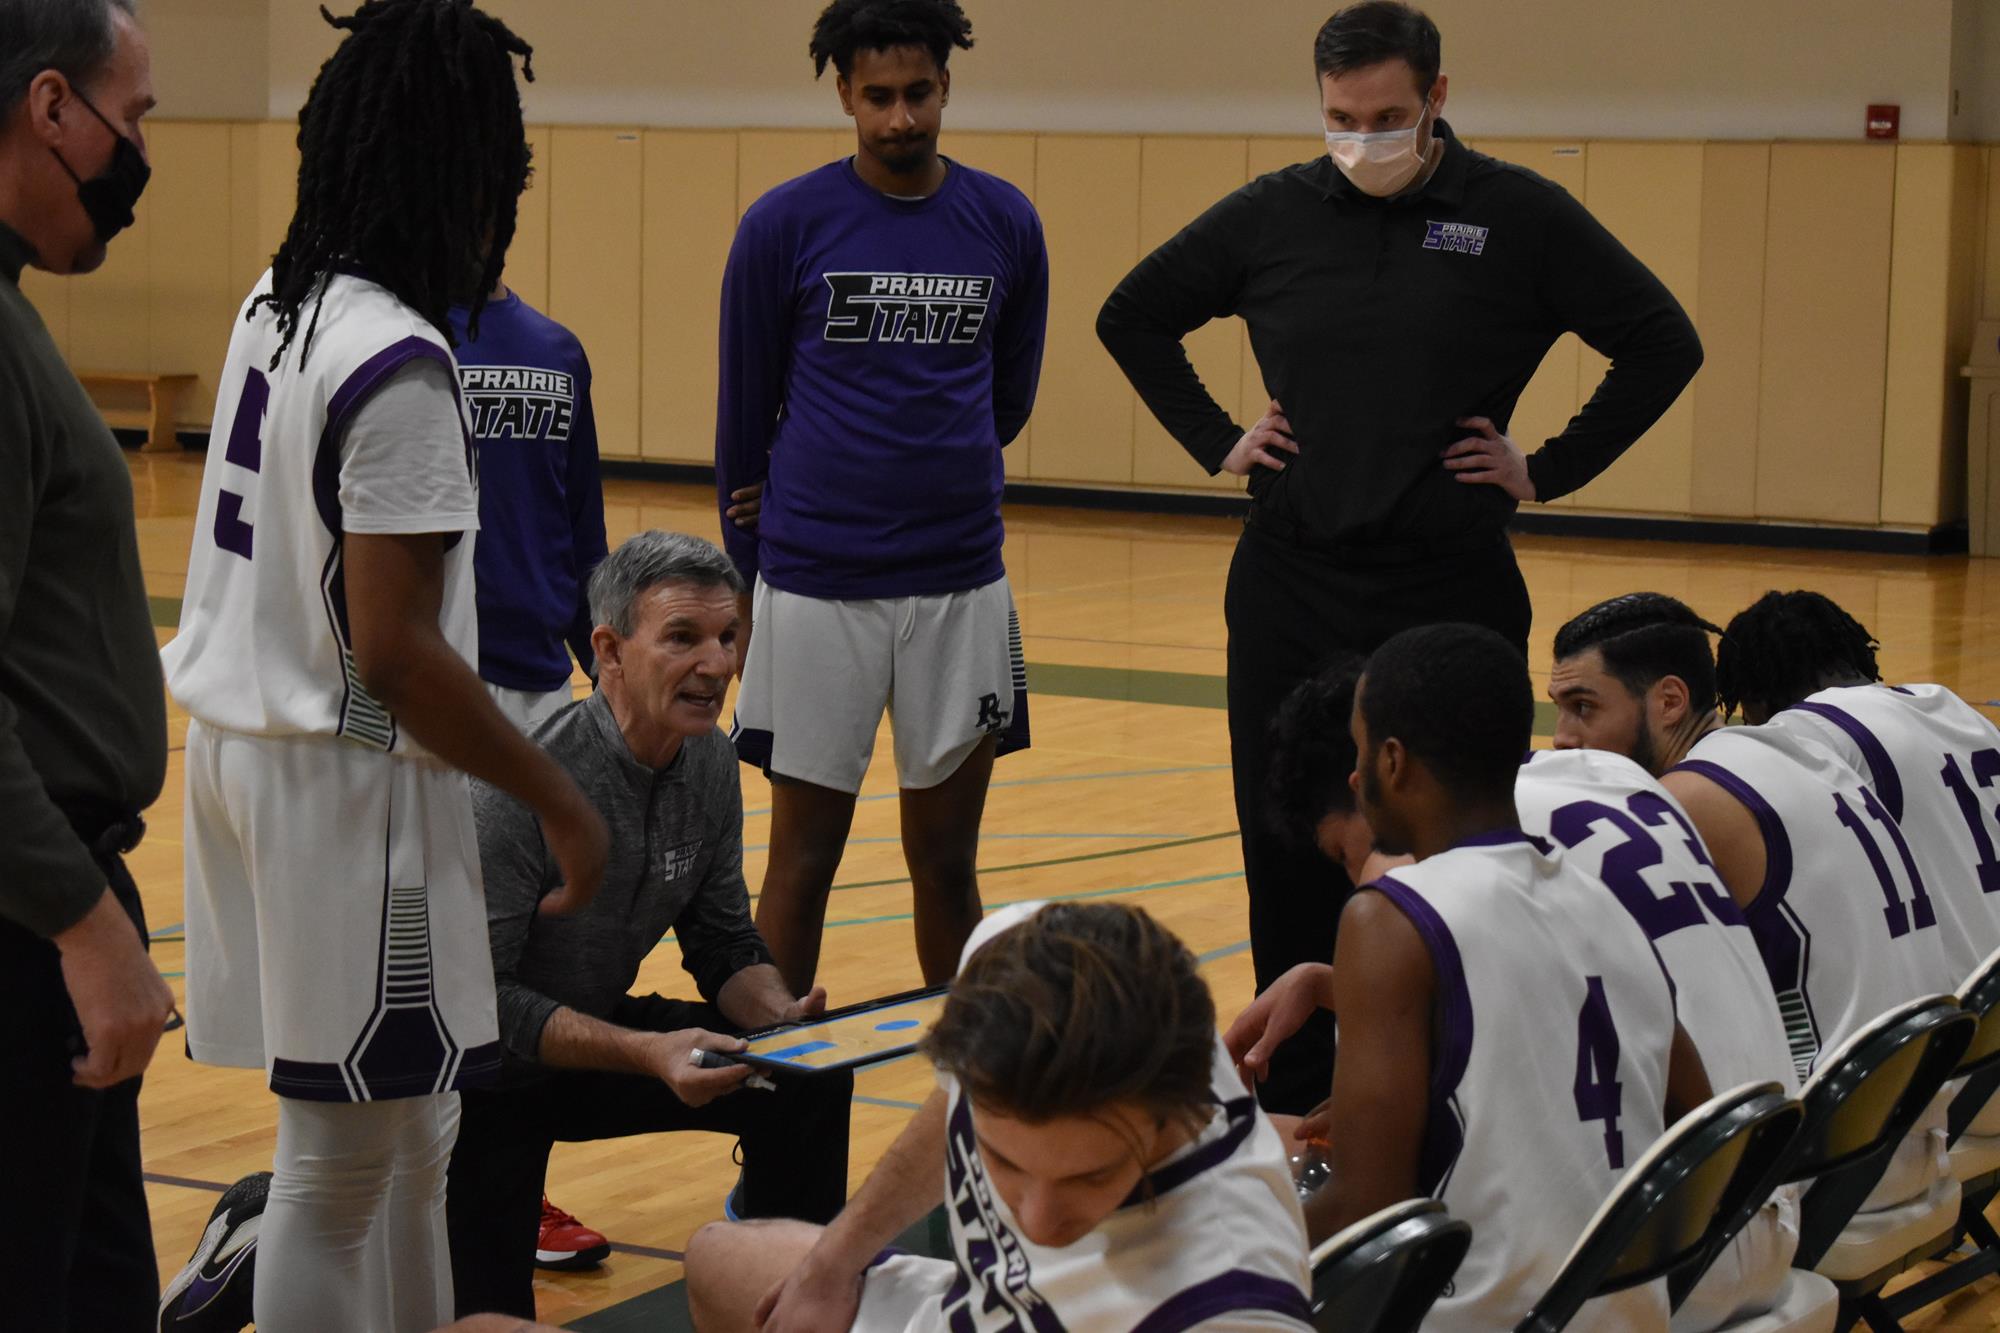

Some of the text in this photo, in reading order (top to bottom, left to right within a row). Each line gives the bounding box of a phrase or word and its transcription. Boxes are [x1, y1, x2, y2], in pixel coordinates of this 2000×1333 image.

[1422, 220, 1485, 255] STATE
[1442, 224, 1483, 237] PRAIRIE
[823, 271, 988, 345] STATE
[869, 275, 987, 299] PRAIRIE
[462, 369, 568, 394] PRAIRIE
[465, 395, 574, 441] TATE
[1550, 790, 1749, 940] 23
[1832, 786, 1937, 939] 11
[1573, 976, 1624, 1169] 4
